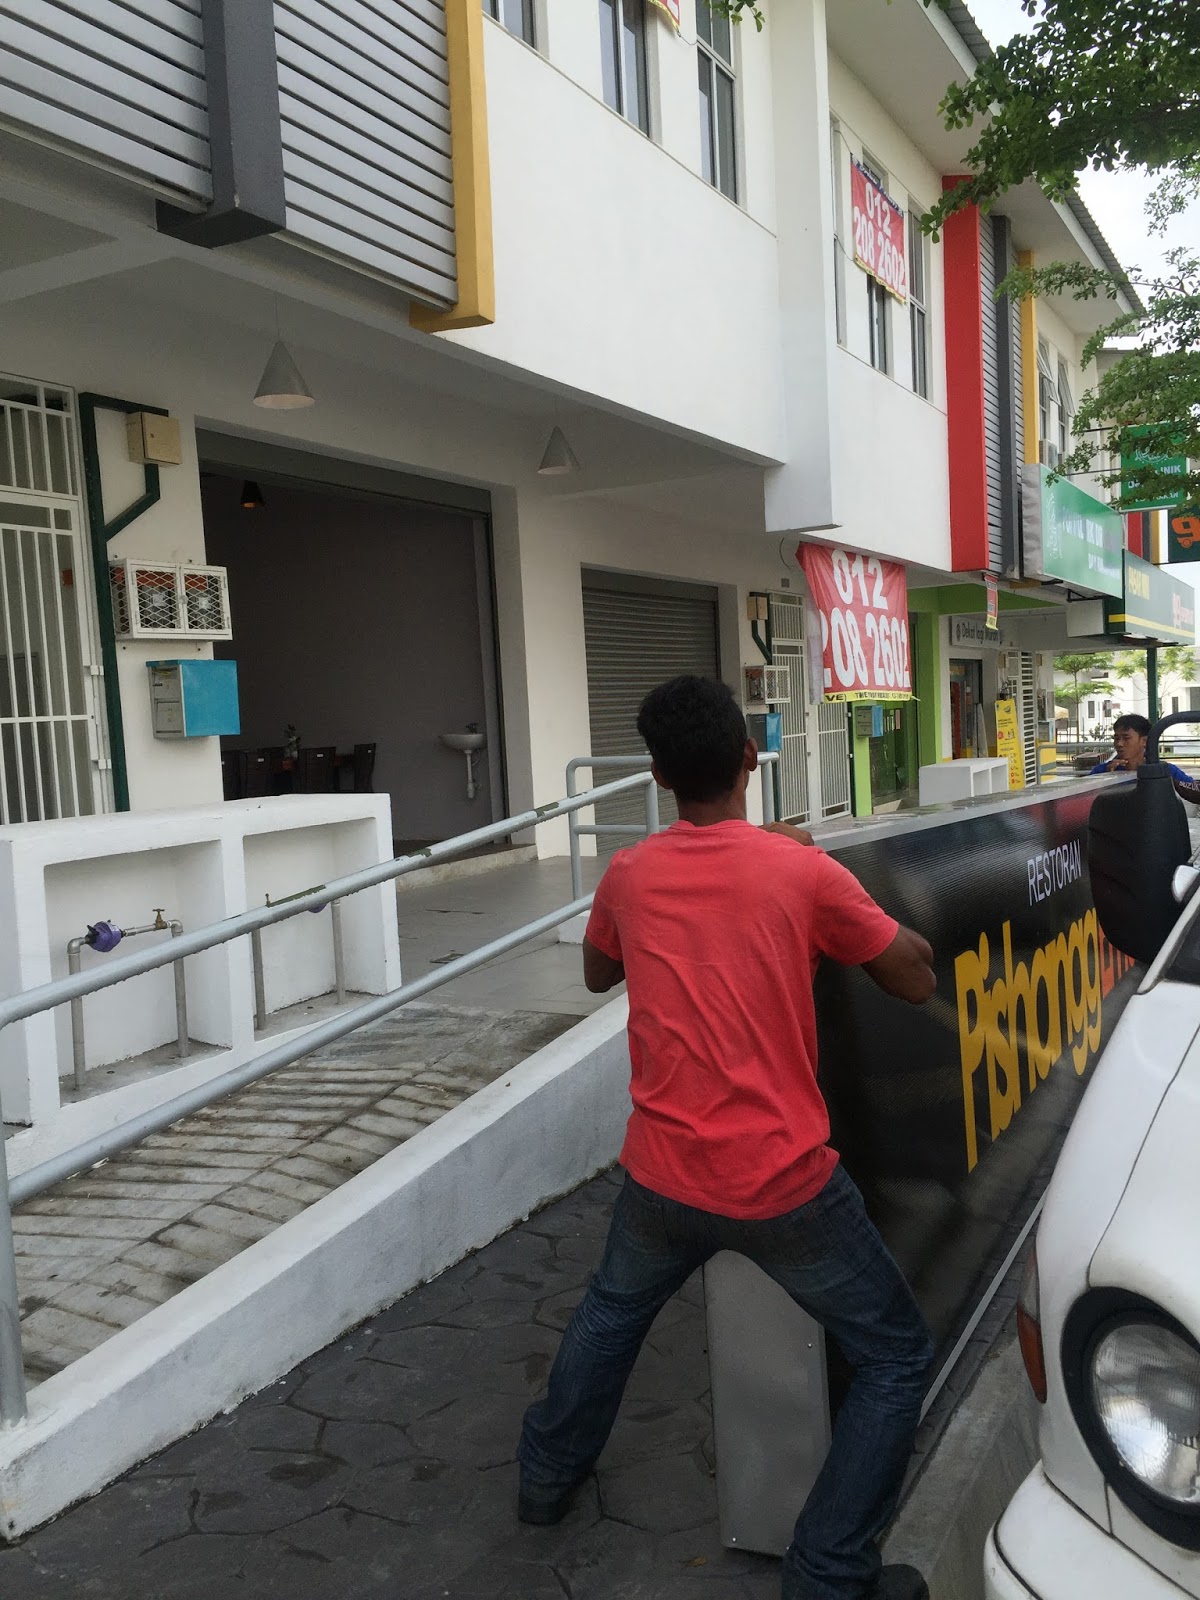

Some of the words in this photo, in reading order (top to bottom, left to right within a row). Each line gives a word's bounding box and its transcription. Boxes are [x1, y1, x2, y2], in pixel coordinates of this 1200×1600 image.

[831, 549, 889, 610] 012
[865, 612, 911, 688] 2602
[1027, 838, 1082, 907] RESTORAN
